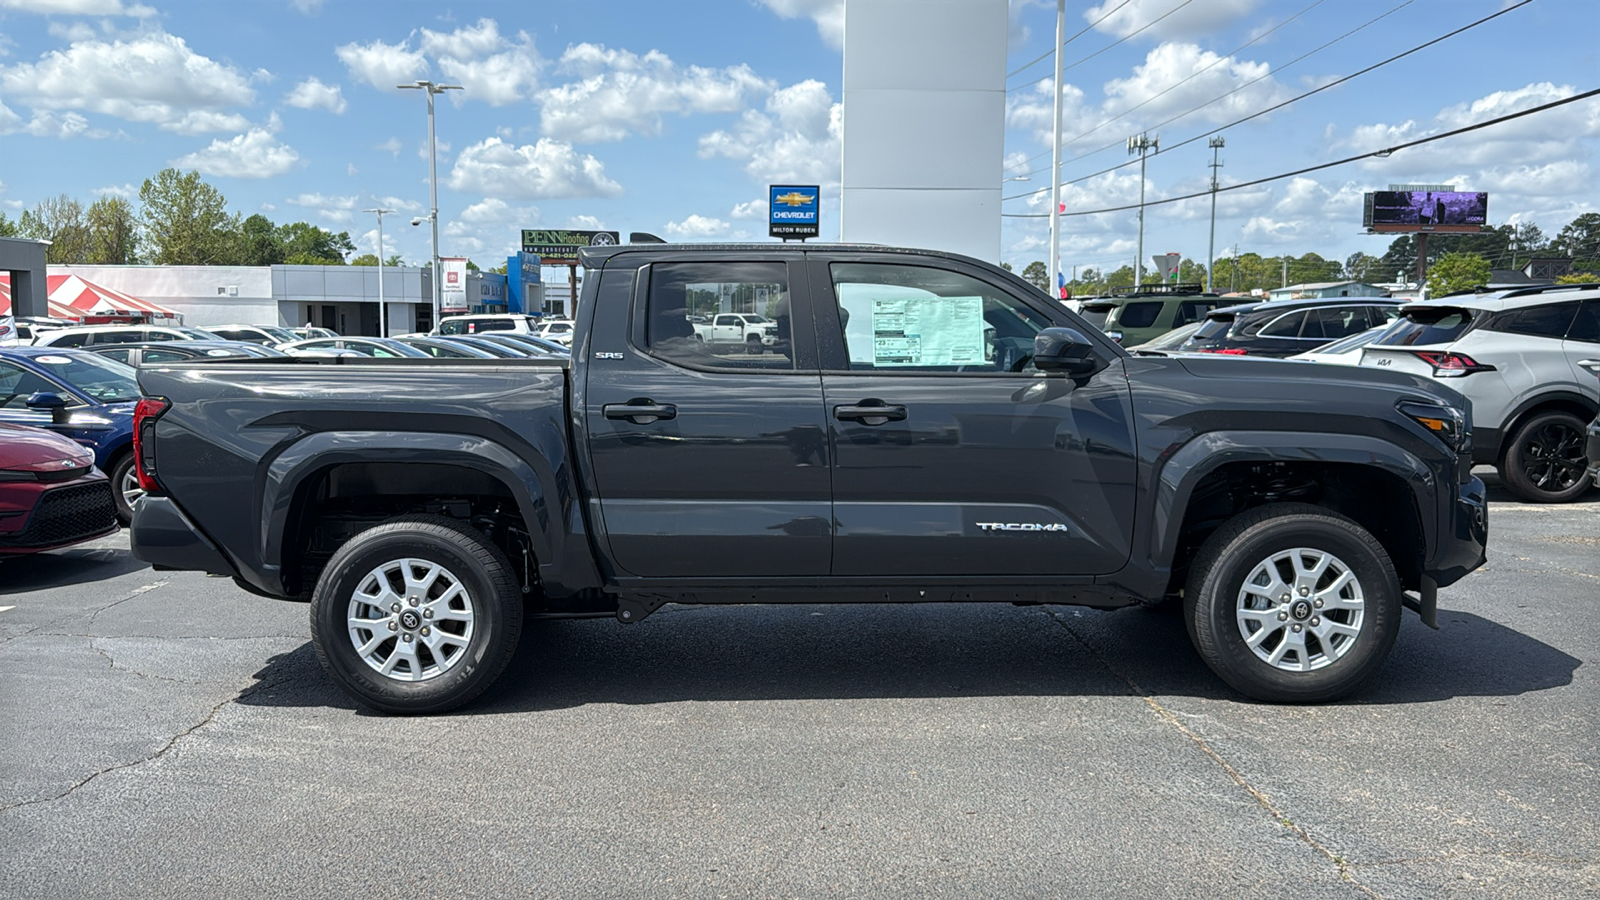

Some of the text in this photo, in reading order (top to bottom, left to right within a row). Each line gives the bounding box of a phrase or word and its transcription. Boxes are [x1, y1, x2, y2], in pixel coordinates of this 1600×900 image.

[773, 211, 815, 219] CHEVROLET
[523, 230, 566, 245] PENN
[563, 233, 590, 246] Roofing
[595, 352, 624, 360] SR5
[975, 522, 1068, 532] TACOMA
